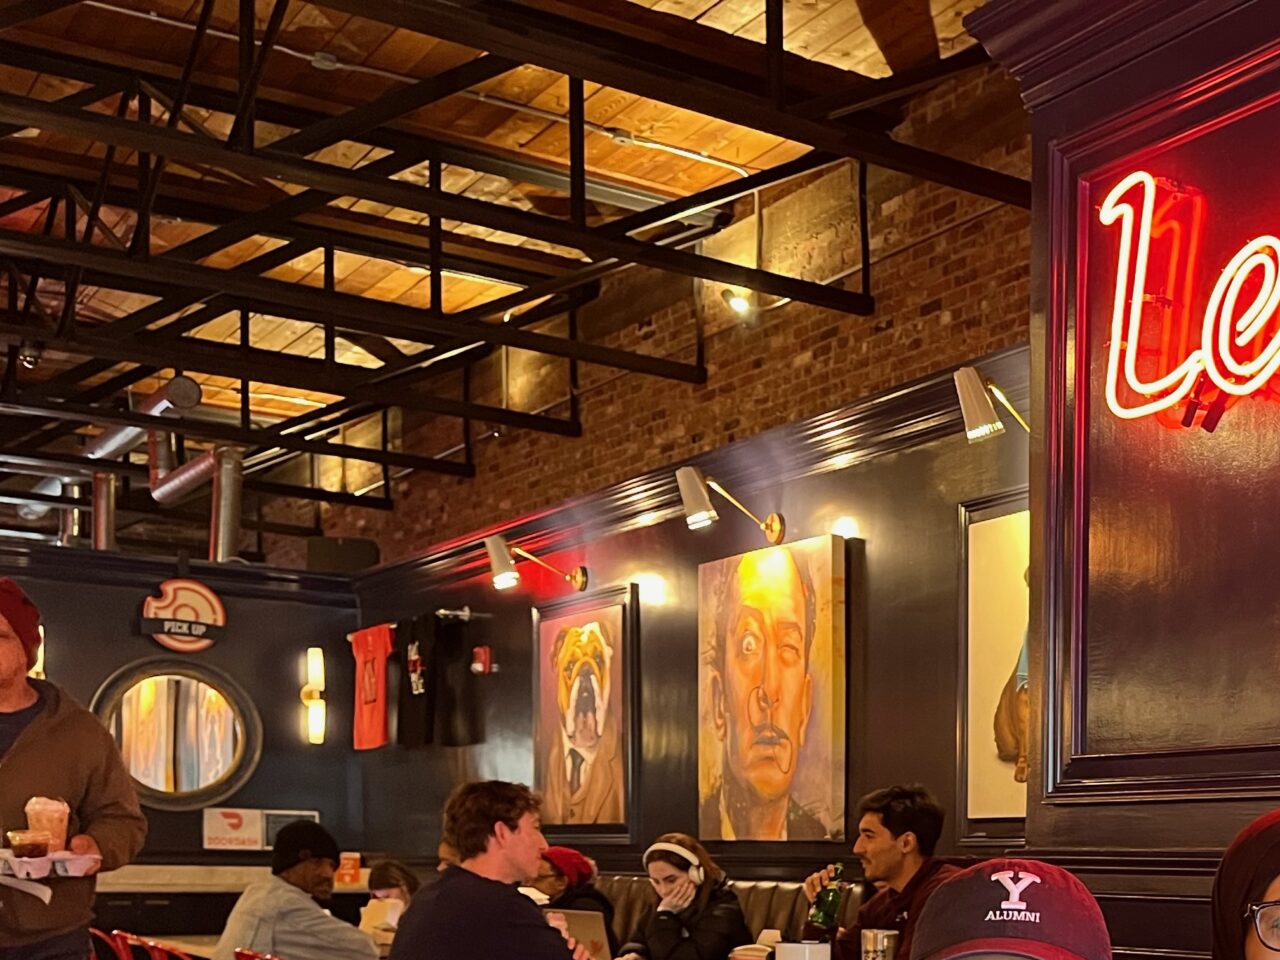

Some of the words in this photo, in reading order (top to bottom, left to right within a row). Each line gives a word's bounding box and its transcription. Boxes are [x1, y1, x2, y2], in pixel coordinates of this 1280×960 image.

[163, 621, 190, 634] PICK
[191, 623, 207, 636] UP
[991, 870, 1041, 910] Y
[984, 910, 1041, 923] ALUMNI
